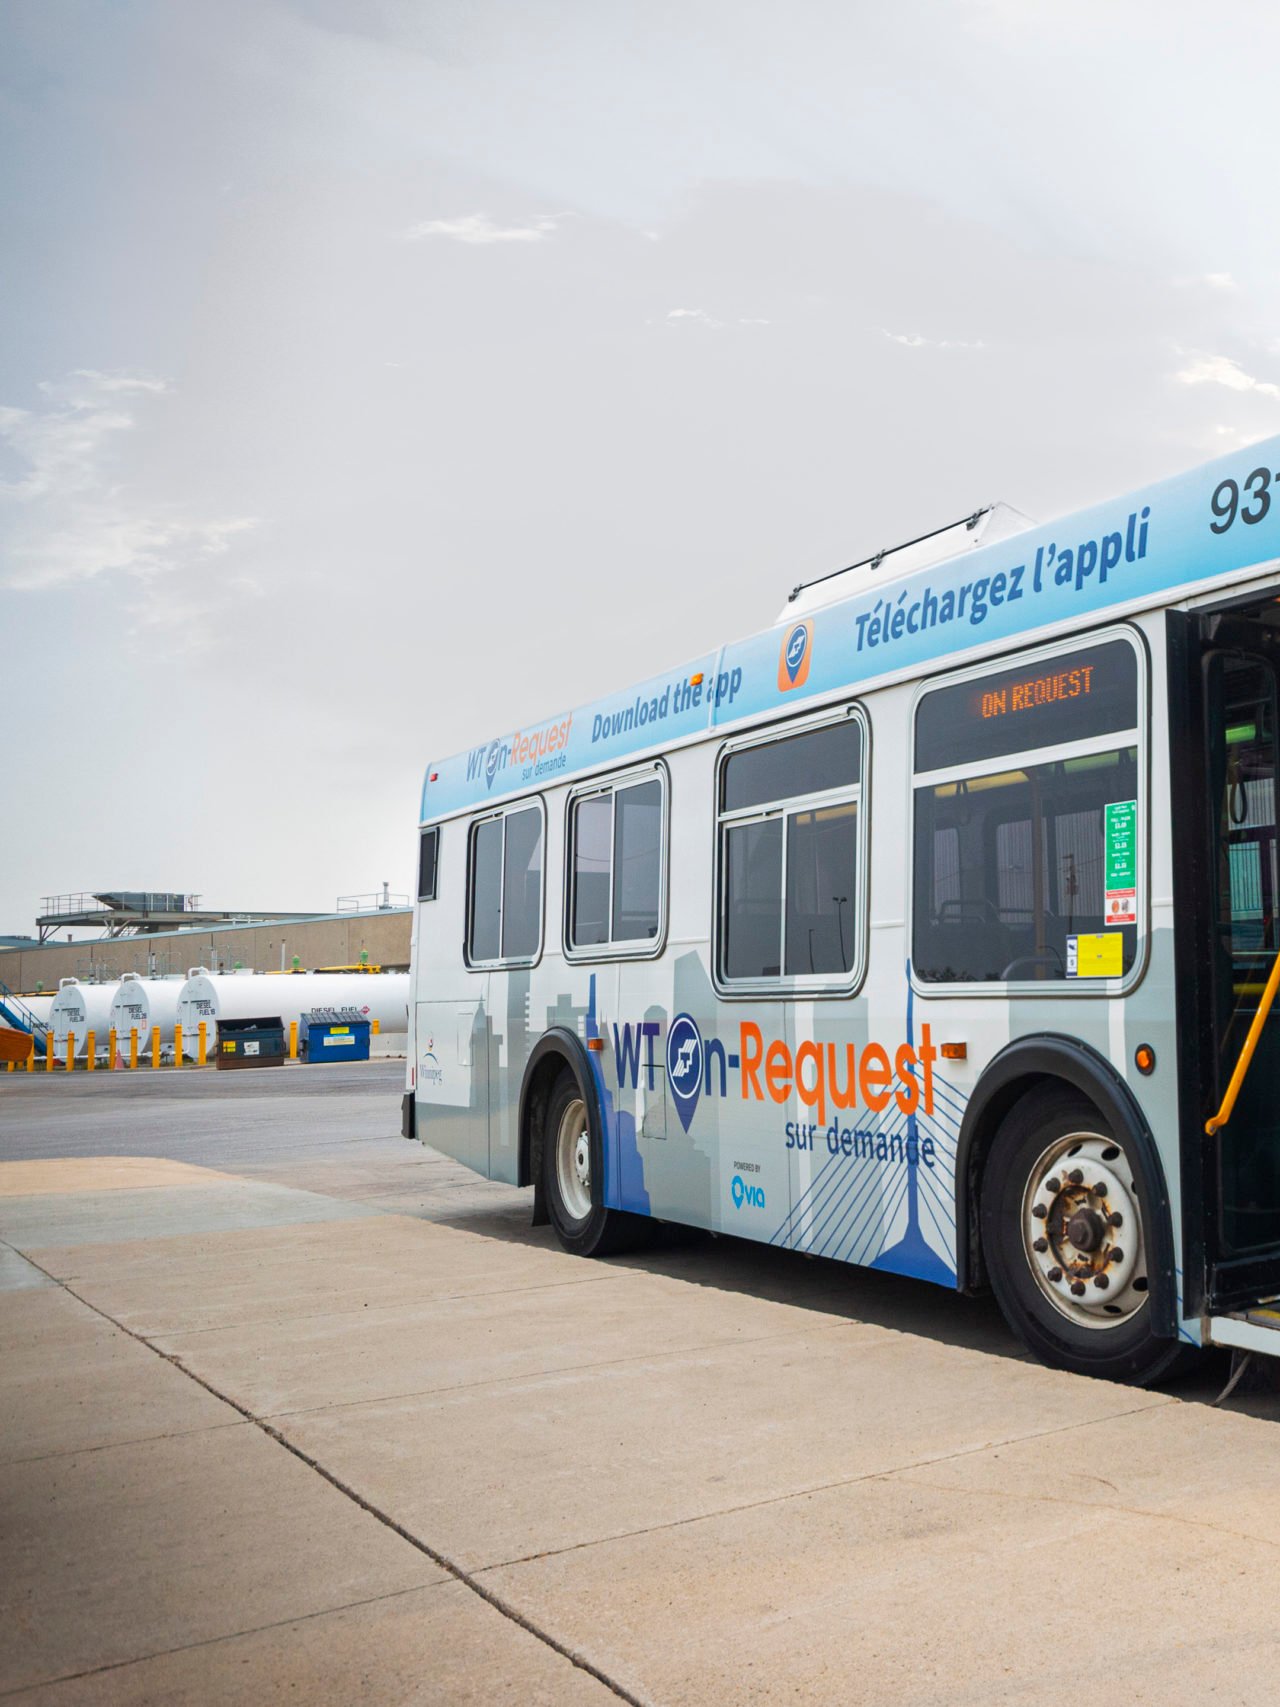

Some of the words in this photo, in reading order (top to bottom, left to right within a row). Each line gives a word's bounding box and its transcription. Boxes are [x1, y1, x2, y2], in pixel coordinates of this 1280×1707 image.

[855, 565, 1025, 652] Téléchargez
[591, 685, 670, 743] Download
[673, 678, 702, 714] the
[982, 689, 1006, 718] ON
[1012, 666, 1094, 711] REQUEST
[466, 744, 486, 782] WT
[521, 765, 533, 781] sur
[535, 753, 567, 778] demande
[613, 1022, 660, 1091] WT
[734, 1161, 754, 1172] POWERED
[785, 1119, 817, 1153] sur
[827, 1116, 936, 1169] demande
